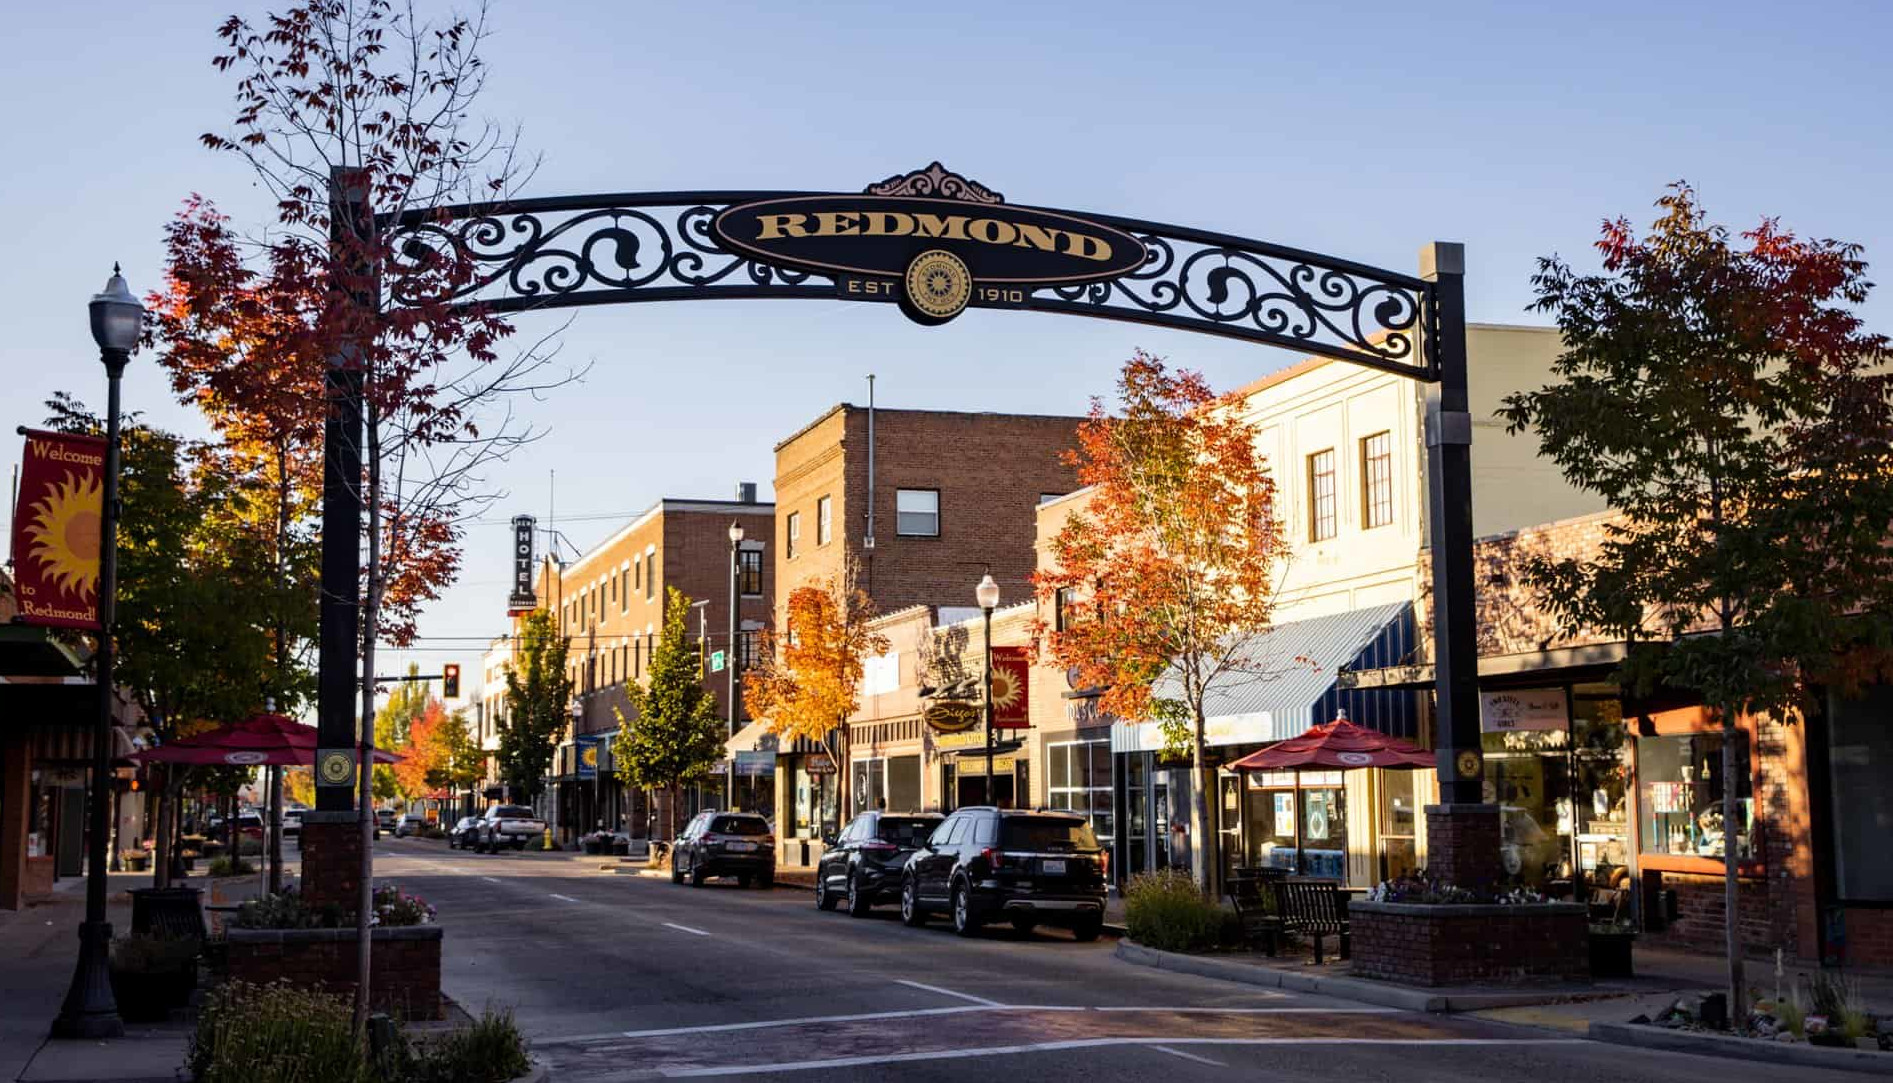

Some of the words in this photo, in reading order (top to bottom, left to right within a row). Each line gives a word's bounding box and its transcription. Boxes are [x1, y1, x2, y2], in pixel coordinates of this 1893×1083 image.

[755, 211, 1113, 262] REDMOND
[848, 280, 894, 294] EST
[978, 288, 1023, 303] 1910
[32, 438, 102, 466] Welcome
[518, 531, 530, 596] HOTEL
[20, 583, 36, 596] to
[22, 599, 97, 622] Redmond!
